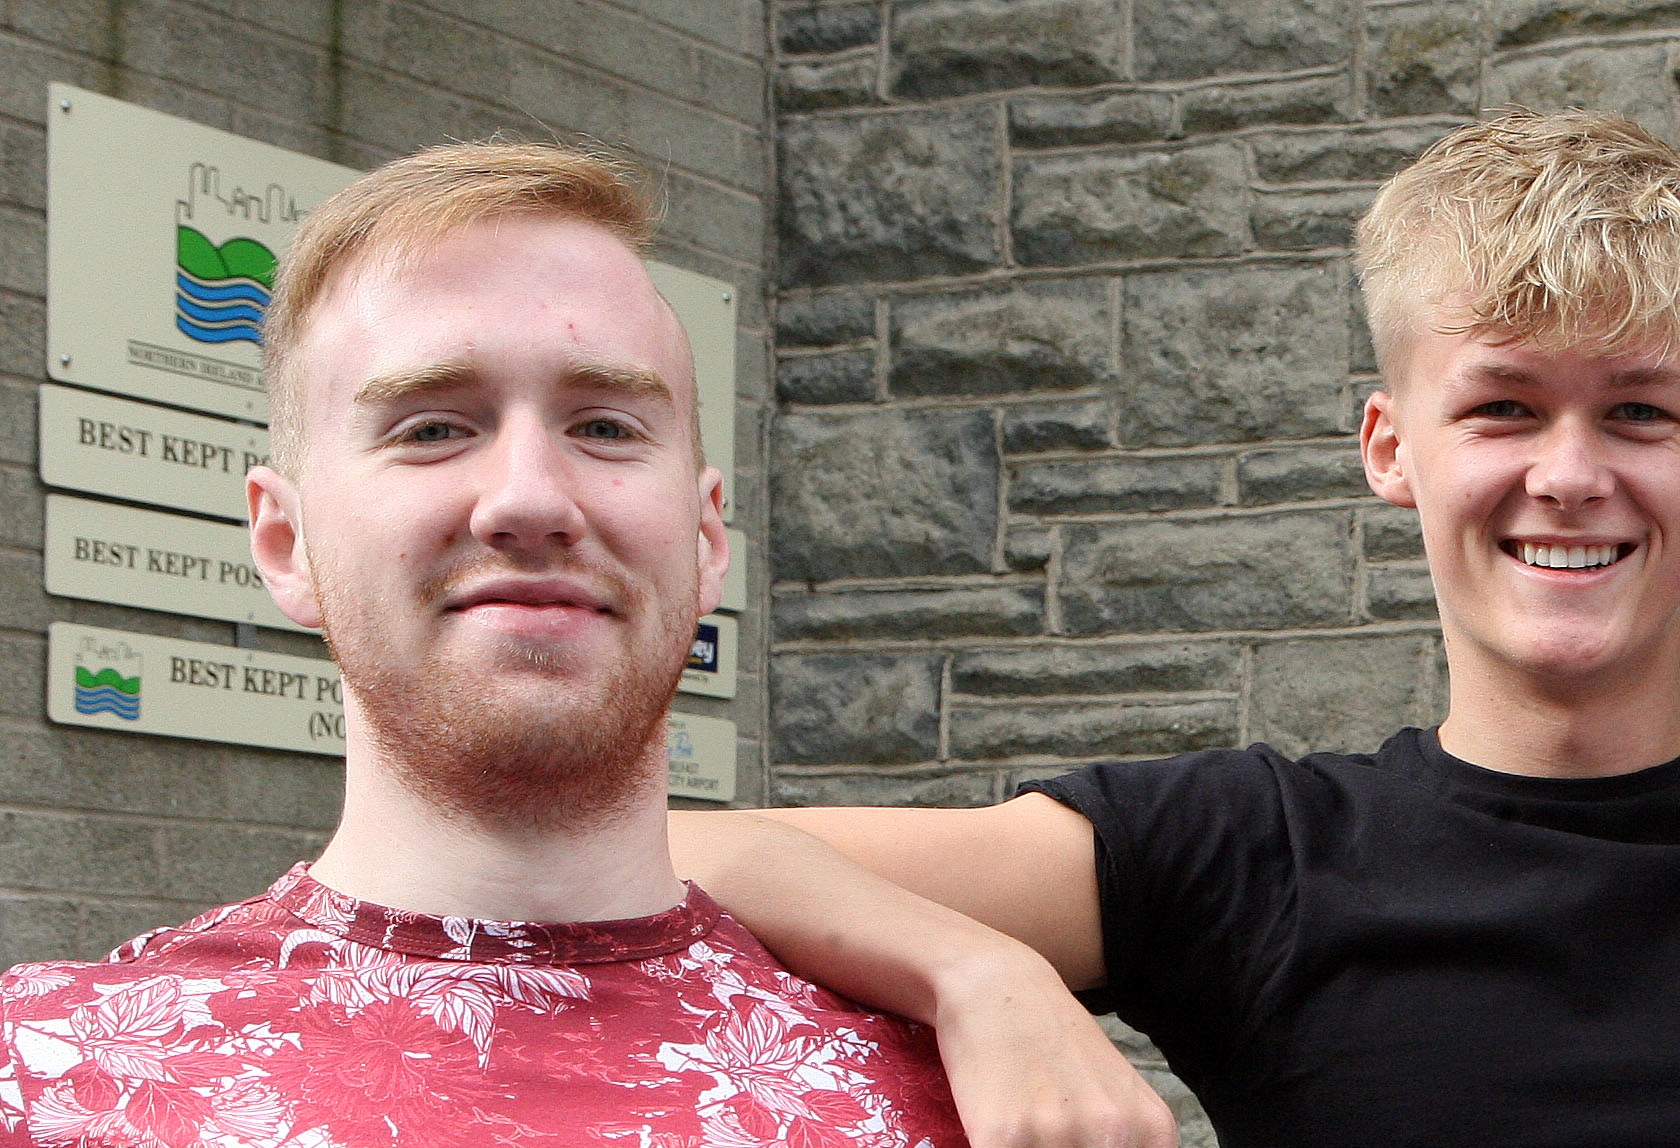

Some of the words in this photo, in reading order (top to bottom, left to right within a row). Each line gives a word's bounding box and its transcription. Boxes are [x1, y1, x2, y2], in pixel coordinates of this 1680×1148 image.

[79, 416, 153, 457] BEST
[161, 433, 233, 473] KEPT
[75, 536, 138, 569] BEST
[147, 548, 212, 580] KEPT
[171, 655, 236, 690] BEST
[243, 665, 308, 699] KEPT
